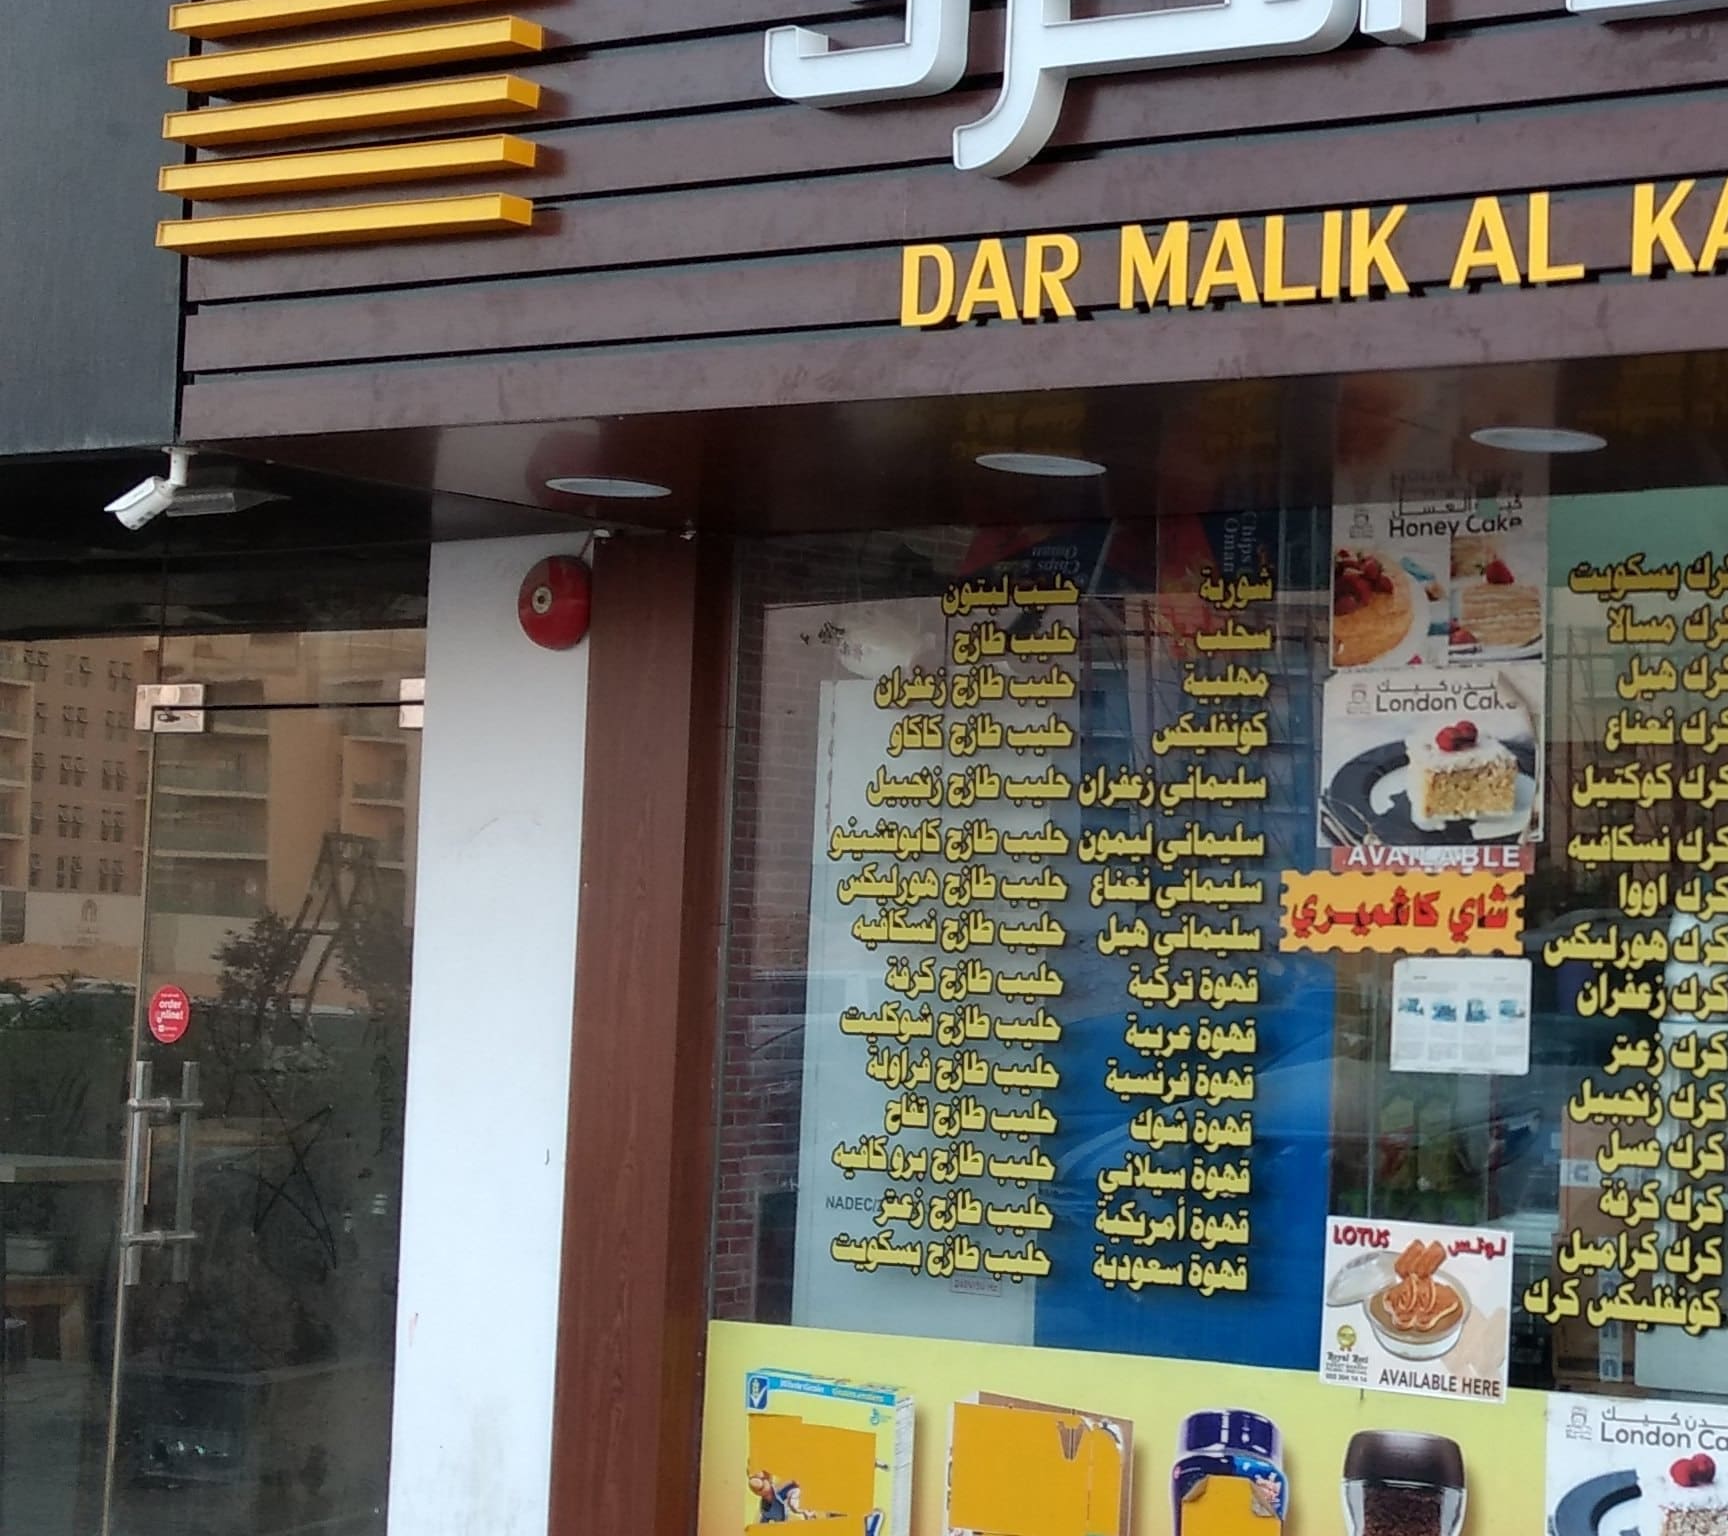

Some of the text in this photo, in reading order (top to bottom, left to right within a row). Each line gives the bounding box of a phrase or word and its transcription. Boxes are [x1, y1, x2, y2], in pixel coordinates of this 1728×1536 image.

[900, 233, 1080, 328] DAR
[1117, 206, 1411, 312] MALIK
[1450, 198, 1584, 286] AL
[1389, 515, 1522, 539] Honey Cake
[942, 574, 1079, 615] حليب لبتون
[1569, 554, 1679, 600] بسكويت
[952, 622, 1077, 665] حليب طازج
[1195, 619, 1272, 652] سحلب
[1608, 606, 1676, 644] مسالا
[874, 667, 1076, 708] حليب طازج زعفران
[1616, 655, 1677, 702] هيل
[1376, 693, 1457, 713] London
[888, 714, 1074, 757] حليب طازج كاكاو
[1150, 712, 1268, 756] كونفليكس
[1603, 707, 1675, 753] نعناع
[868, 766, 1071, 808] حليب طازج زنجبيل
[1077, 768, 1267, 814] سليماني زعفران
[944, 823, 999, 862] طازج
[1001, 820, 1070, 855] حليب
[1076, 824, 1265, 865] سليماني ليمون
[1566, 822, 1671, 871] نسكافيه
[840, 865, 1068, 907] حليب طازج هورليكس
[1090, 867, 1263, 911] سليماني نعناع
[1291, 883, 1508, 943] شاي كاشميري
[1099, 916, 1261, 958] سليماني هيل
[1542, 921, 1669, 971] هورليكس
[159, 999, 182, 1009] order
[1130, 965, 1259, 1006] قهوة تركية
[1575, 974, 1667, 1019] زعفران
[938, 1006, 991, 1046] طازج
[993, 1011, 1062, 1046] حليب
[1127, 1015, 1257, 1058] قهوة عربية
[868, 1050, 1059, 1093] حليب طازج فراولة
[1669, 1035, 1728, 1079] كرك
[1107, 1060, 1253, 1104] قهوة فرنسية
[886, 1095, 1054, 1139] حليب طازج تفاح
[1567, 1082, 1727, 1130] كرك زنجبيل
[1193, 1114, 1252, 1150] قهوة
[1596, 1129, 1726, 1181] كرك عسل
[1190, 1161, 1249, 1199] قهوة
[929, 1193, 981, 1230] طازج
[988, 1198, 1051, 1233] حليب
[1096, 1200, 1247, 1248] قهوة أمريكية
[1665, 1186, 1724, 1233] كرك
[833, 1232, 1048, 1280] حليب طازج بسكويت
[1333, 1224, 1390, 1248] LOTUS
[1448, 1236, 1506, 1260] لوتس
[1557, 1226, 1723, 1284] كرك كراميل
[1095, 1249, 1246, 1294] قهوة سعودية
[1522, 1277, 1721, 1335] كونفليكس كرك
[1379, 1368, 1457, 1392] AVAILABLE
[1462, 1376, 1500, 1397] HERE
[1600, 1421, 1691, 1448] London
[1601, 1406, 1681, 1426] كيك
